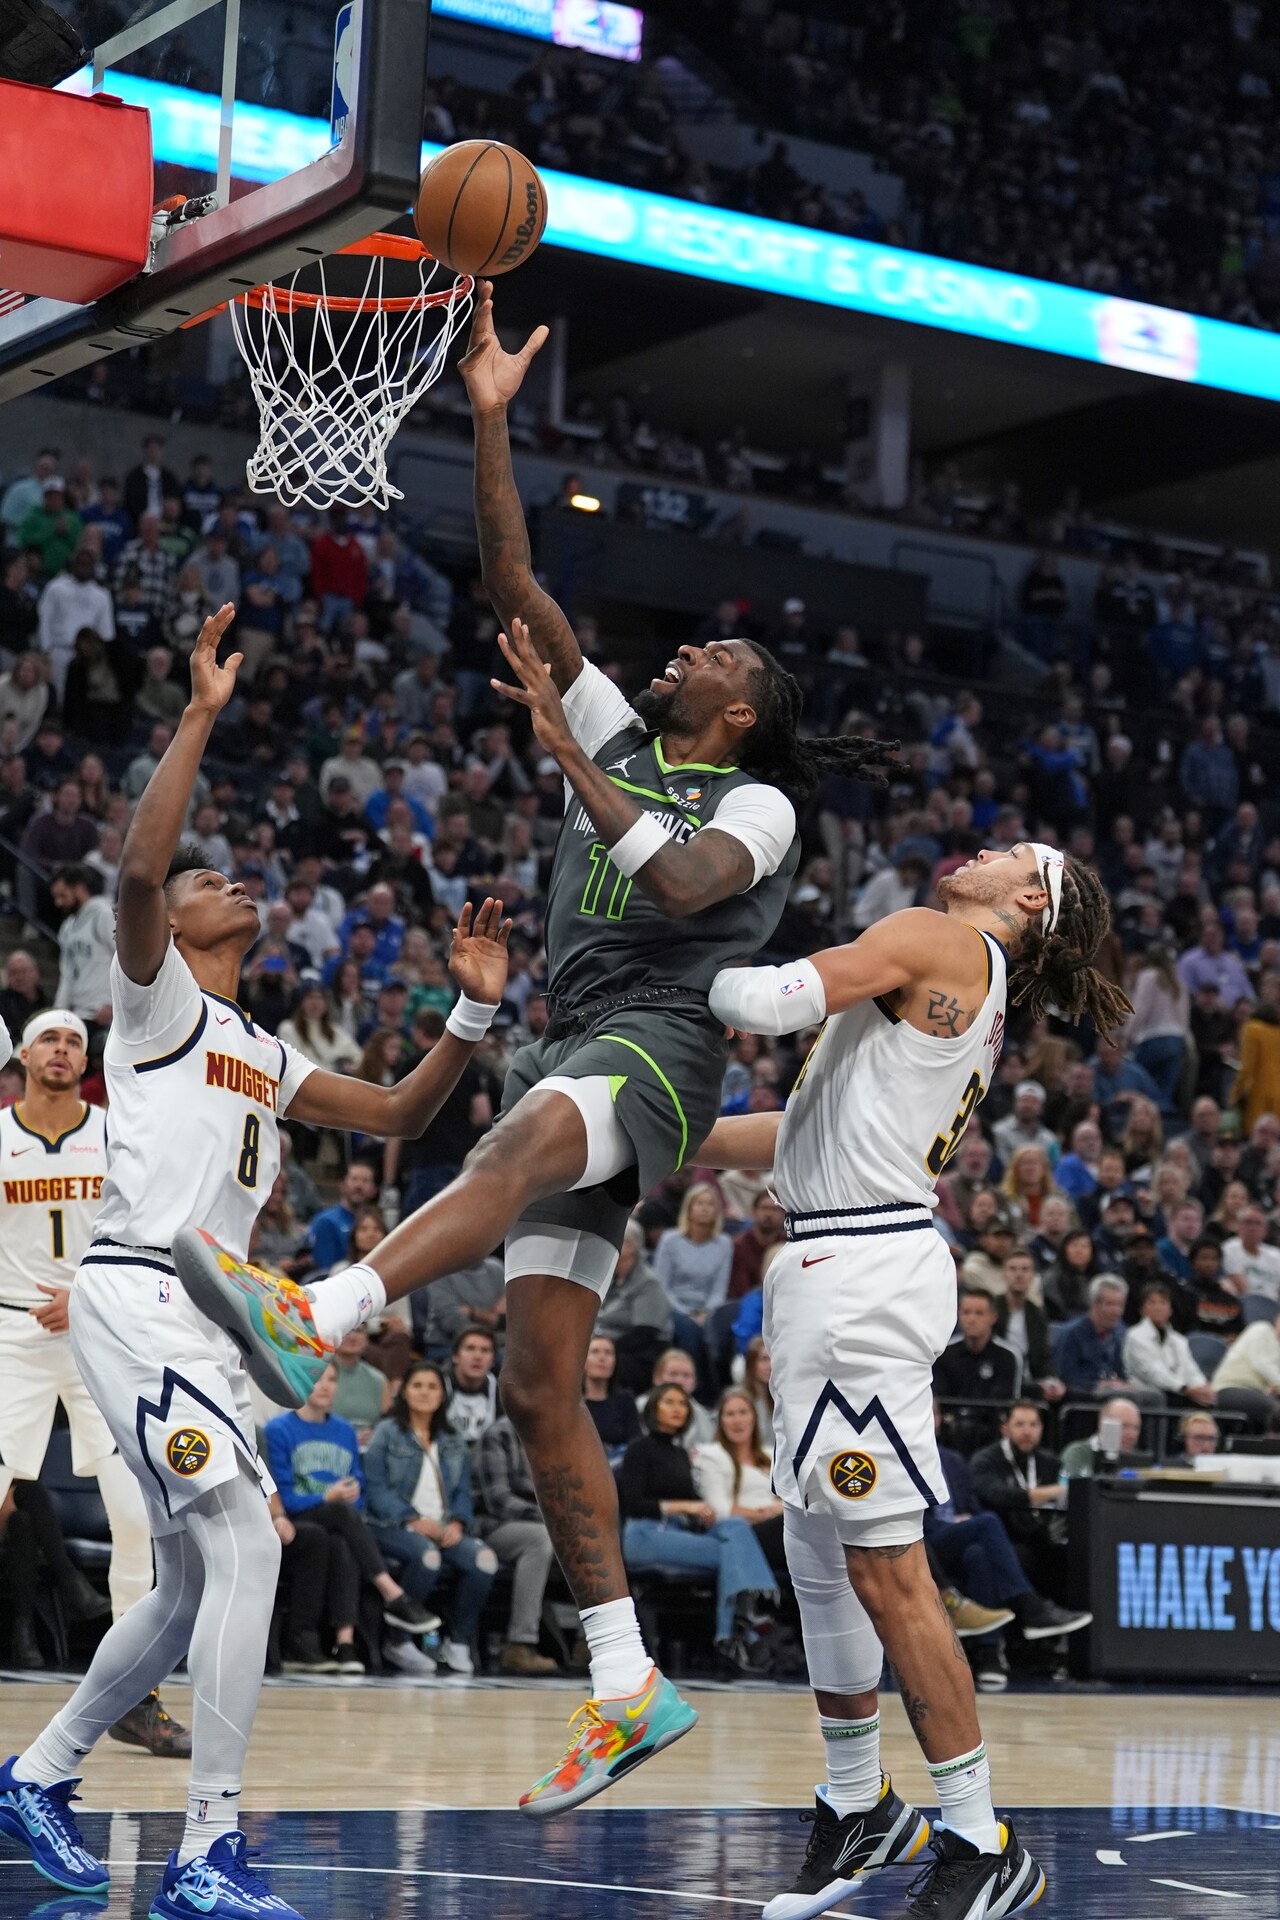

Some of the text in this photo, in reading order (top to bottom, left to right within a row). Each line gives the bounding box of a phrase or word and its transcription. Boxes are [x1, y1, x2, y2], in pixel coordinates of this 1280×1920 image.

[496, 181, 538, 266] Wilson
[644, 203, 820, 284] RESORT
[824, 247, 862, 295] &
[868, 256, 1040, 332] CASINO
[666, 785, 701, 811] sezzle
[580, 843, 633, 921] 11
[3, 1174, 104, 1205] NUGGETS
[236, 1110, 261, 1191] 8
[48, 1208, 64, 1260] 1
[1117, 1541, 1236, 1630] MAKE
